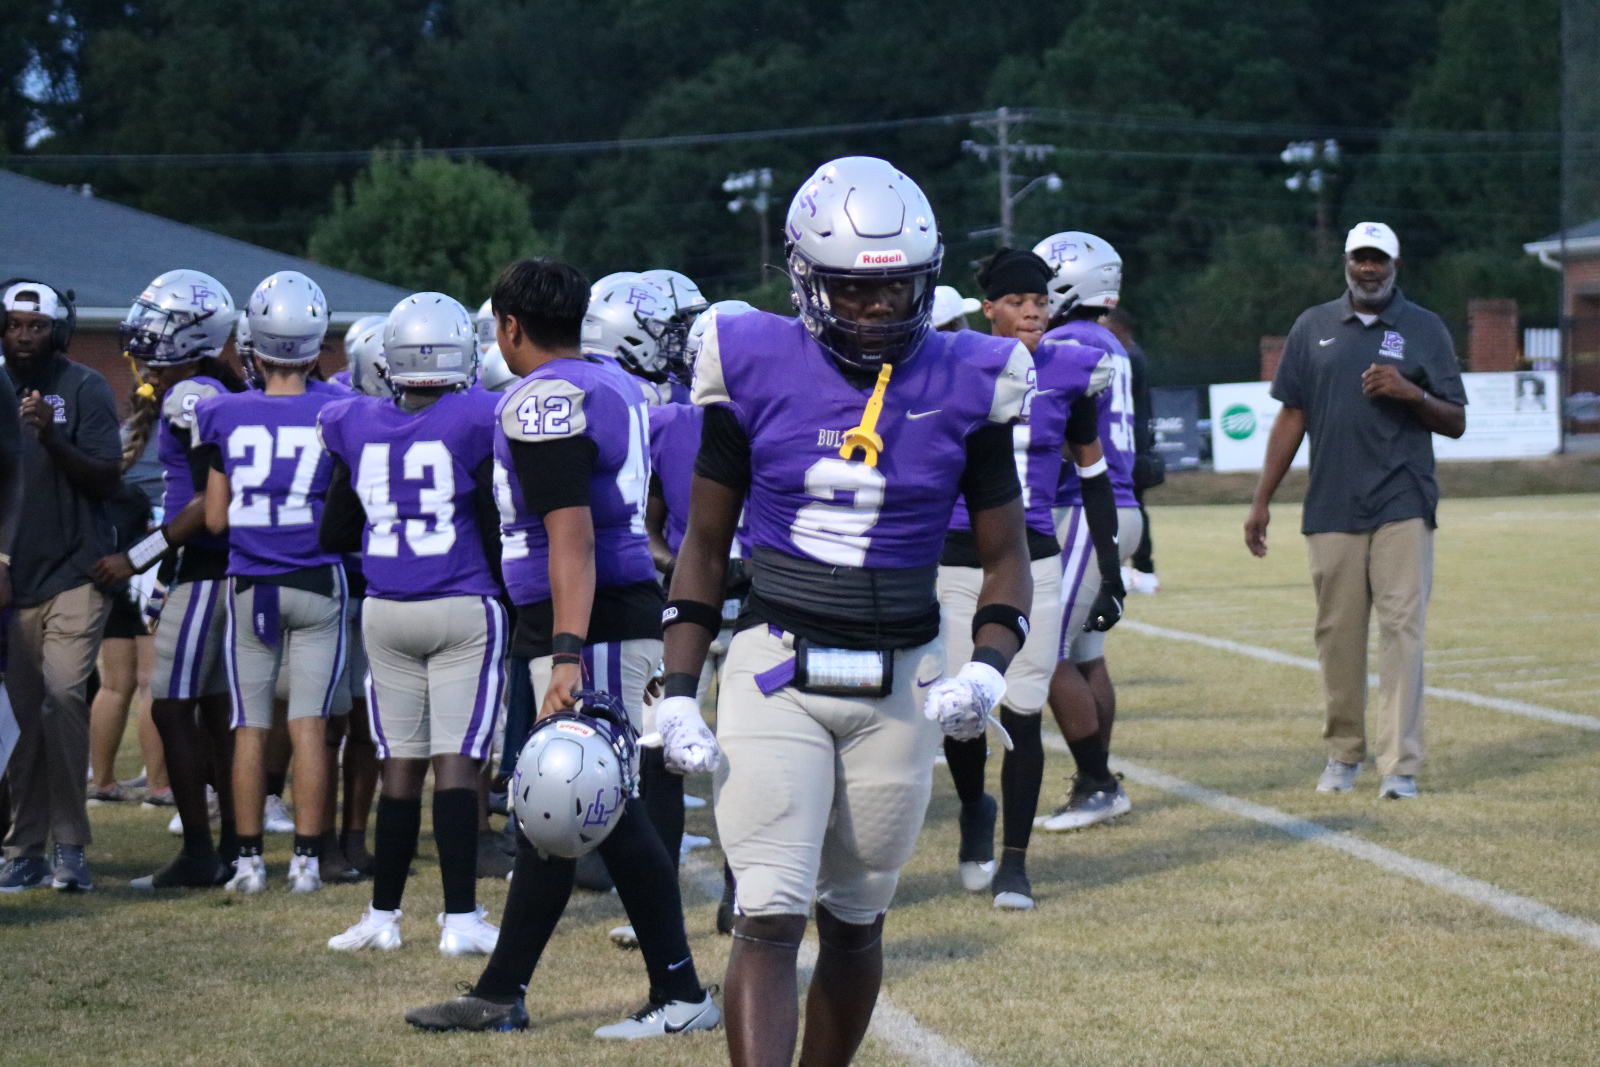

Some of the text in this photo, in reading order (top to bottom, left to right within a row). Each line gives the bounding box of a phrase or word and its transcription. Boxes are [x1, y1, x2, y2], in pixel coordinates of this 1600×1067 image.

[862, 253, 902, 264] Riddell
[1381, 330, 1405, 352] PC
[516, 395, 572, 435] 42
[227, 424, 323, 527] 27
[356, 439, 457, 557] 43
[790, 456, 887, 567] 2
